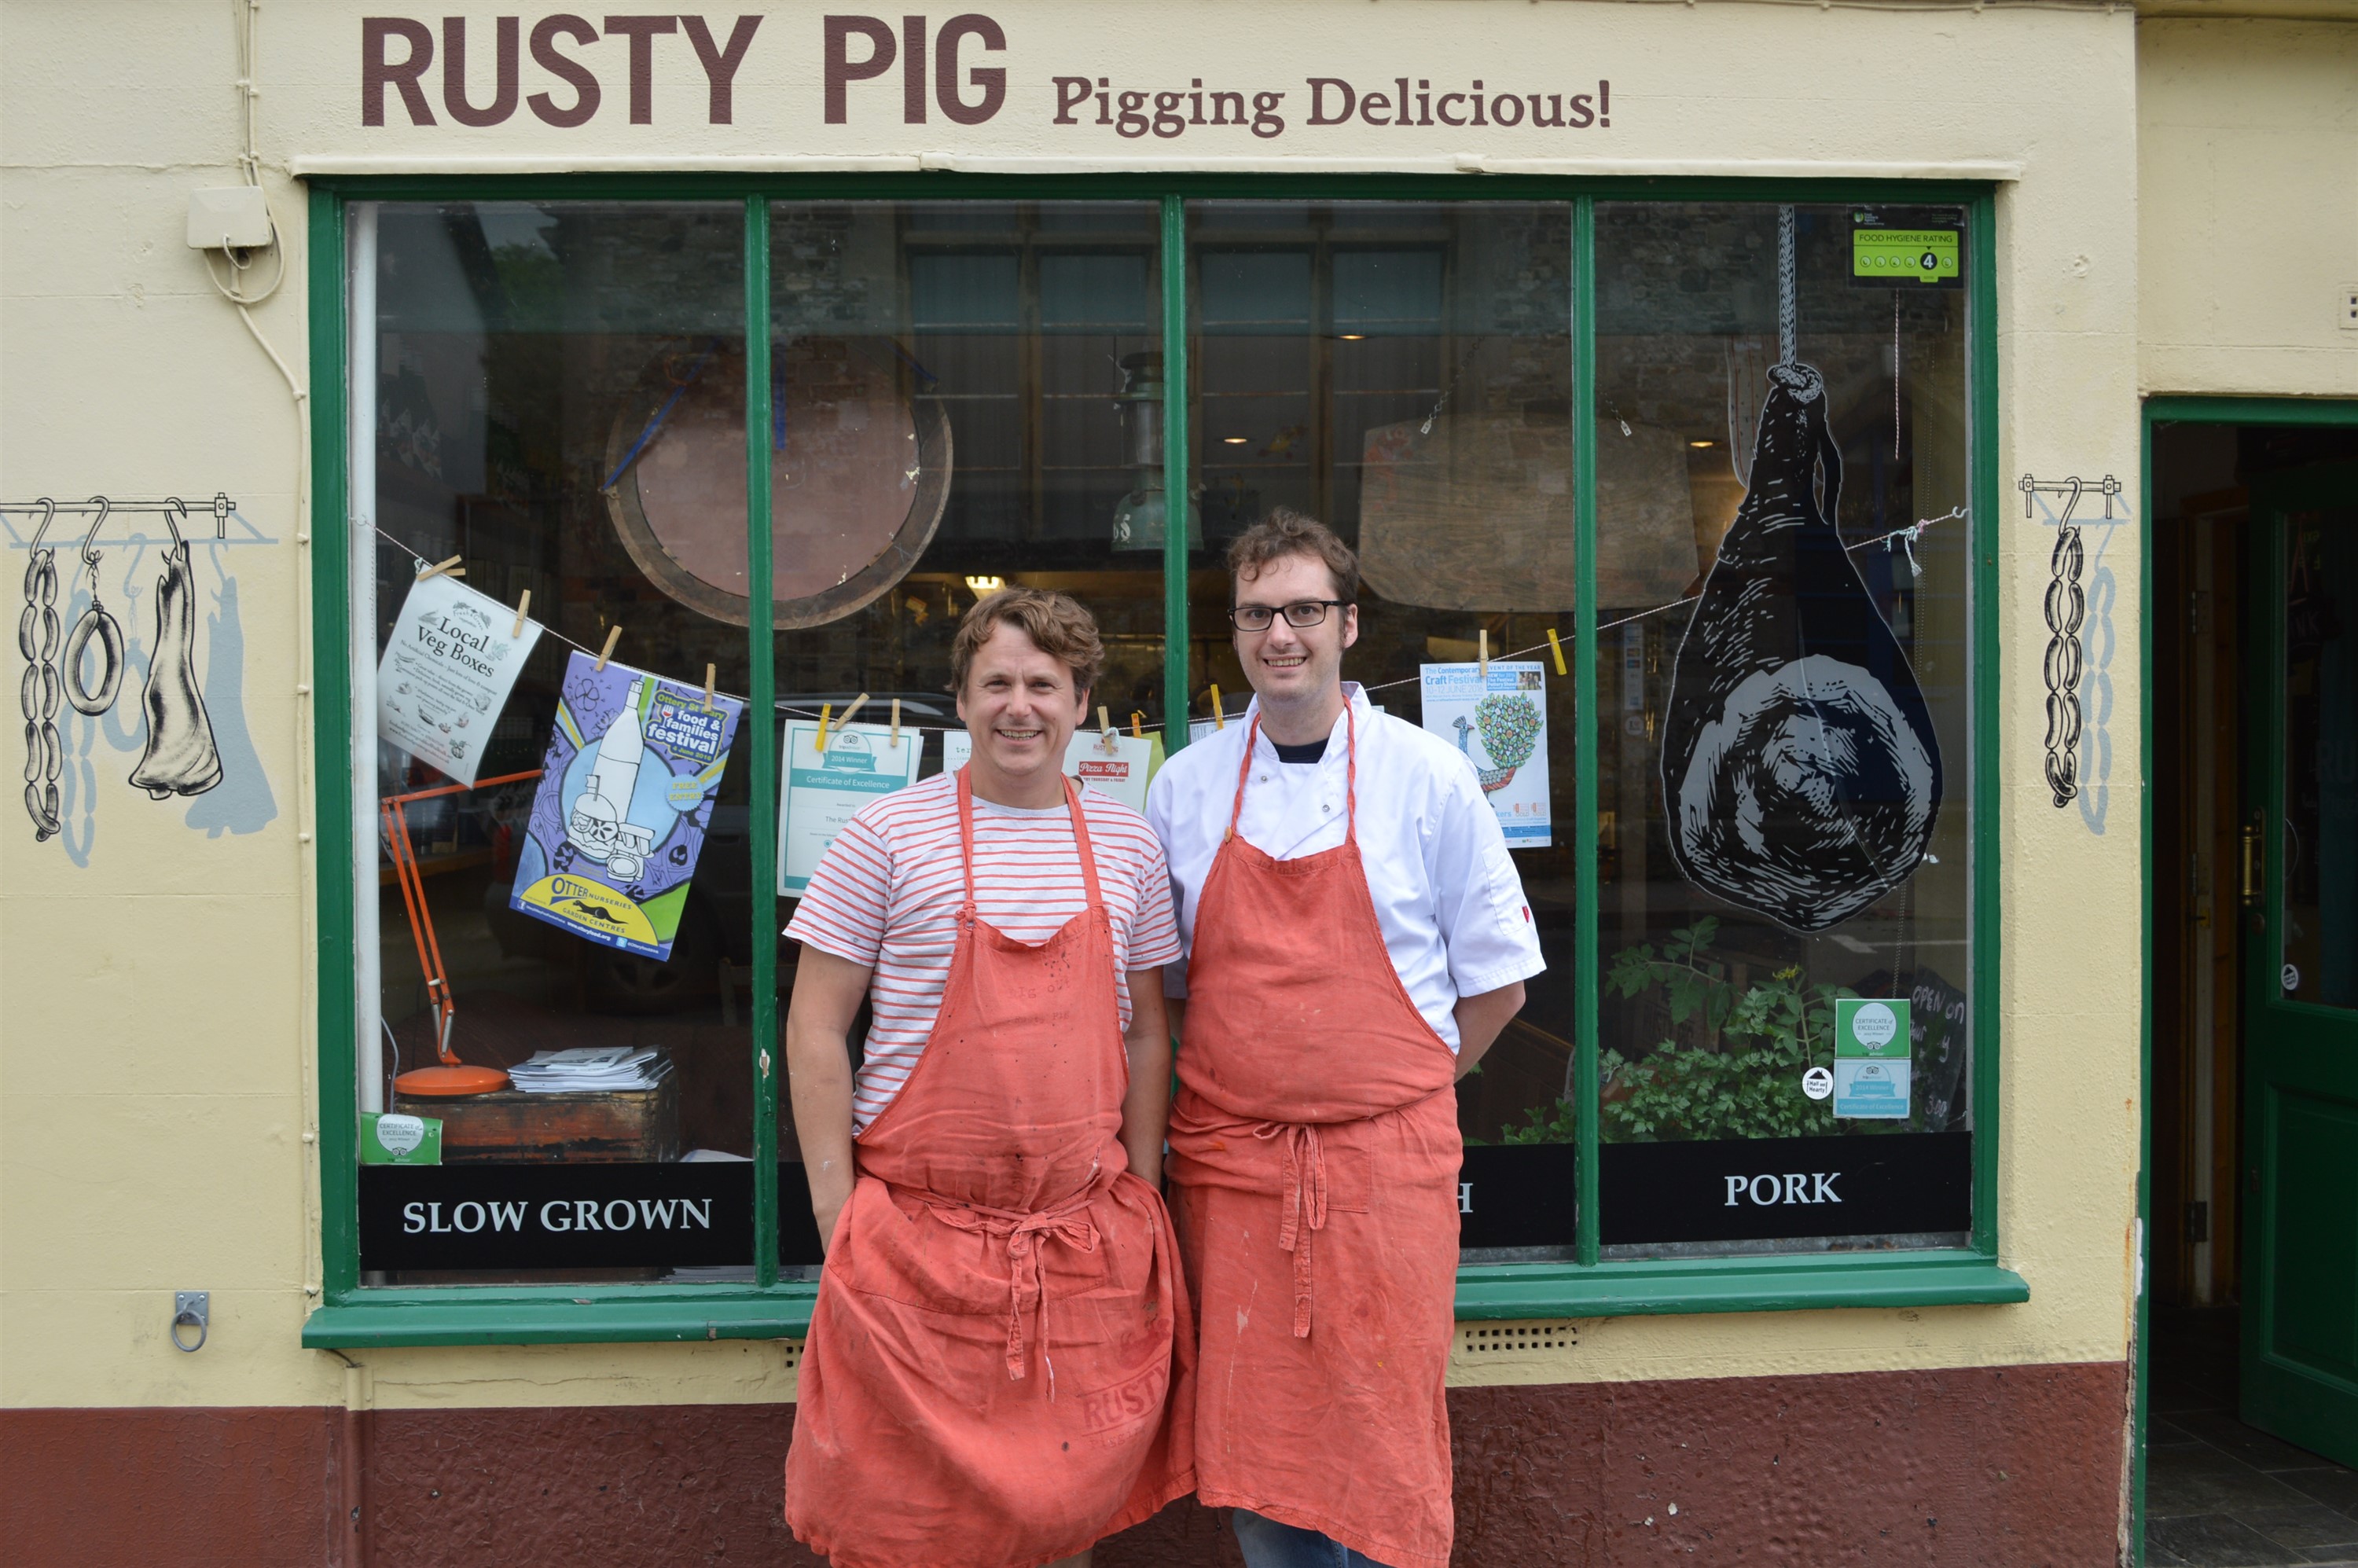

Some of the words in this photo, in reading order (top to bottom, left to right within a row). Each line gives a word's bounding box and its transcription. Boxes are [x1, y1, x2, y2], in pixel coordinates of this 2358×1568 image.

[362, 13, 764, 128] RUSTY
[824, 13, 1006, 125] PIG
[1052, 76, 1286, 138] Pigging
[1306, 77, 1611, 128] Delicious!
[1923, 255, 1934, 268] 4
[437, 616, 490, 653] Local
[417, 625, 448, 656] Veg
[450, 642, 494, 678] Boxes
[1426, 675, 1447, 685] Craft
[1448, 674, 1482, 685] Festival
[658, 694, 686, 709] Ottery
[689, 703, 700, 712] St
[667, 718, 718, 740] families
[678, 711, 708, 727] food
[711, 720, 721, 731] &
[648, 723, 717, 755] festival
[696, 751, 712, 760] 2016
[1080, 762, 1103, 773] Pizza
[1105, 762, 1128, 776] Night
[672, 781, 698, 790] FREE
[806, 775, 843, 786] Certificate
[852, 780, 890, 789] Excellence
[669, 792, 702, 801] ENTRY
[551, 877, 589, 898] OTTER
[589, 893, 632, 910] NURSERIES
[563, 907, 587, 922] GARDEN
[590, 919, 626, 934] CENTRES
[1912, 986, 1946, 1013] OPEN
[1724, 1172, 1842, 1206] PORK
[403, 1200, 528, 1234] SLOW
[540, 1198, 712, 1232] GROWN
